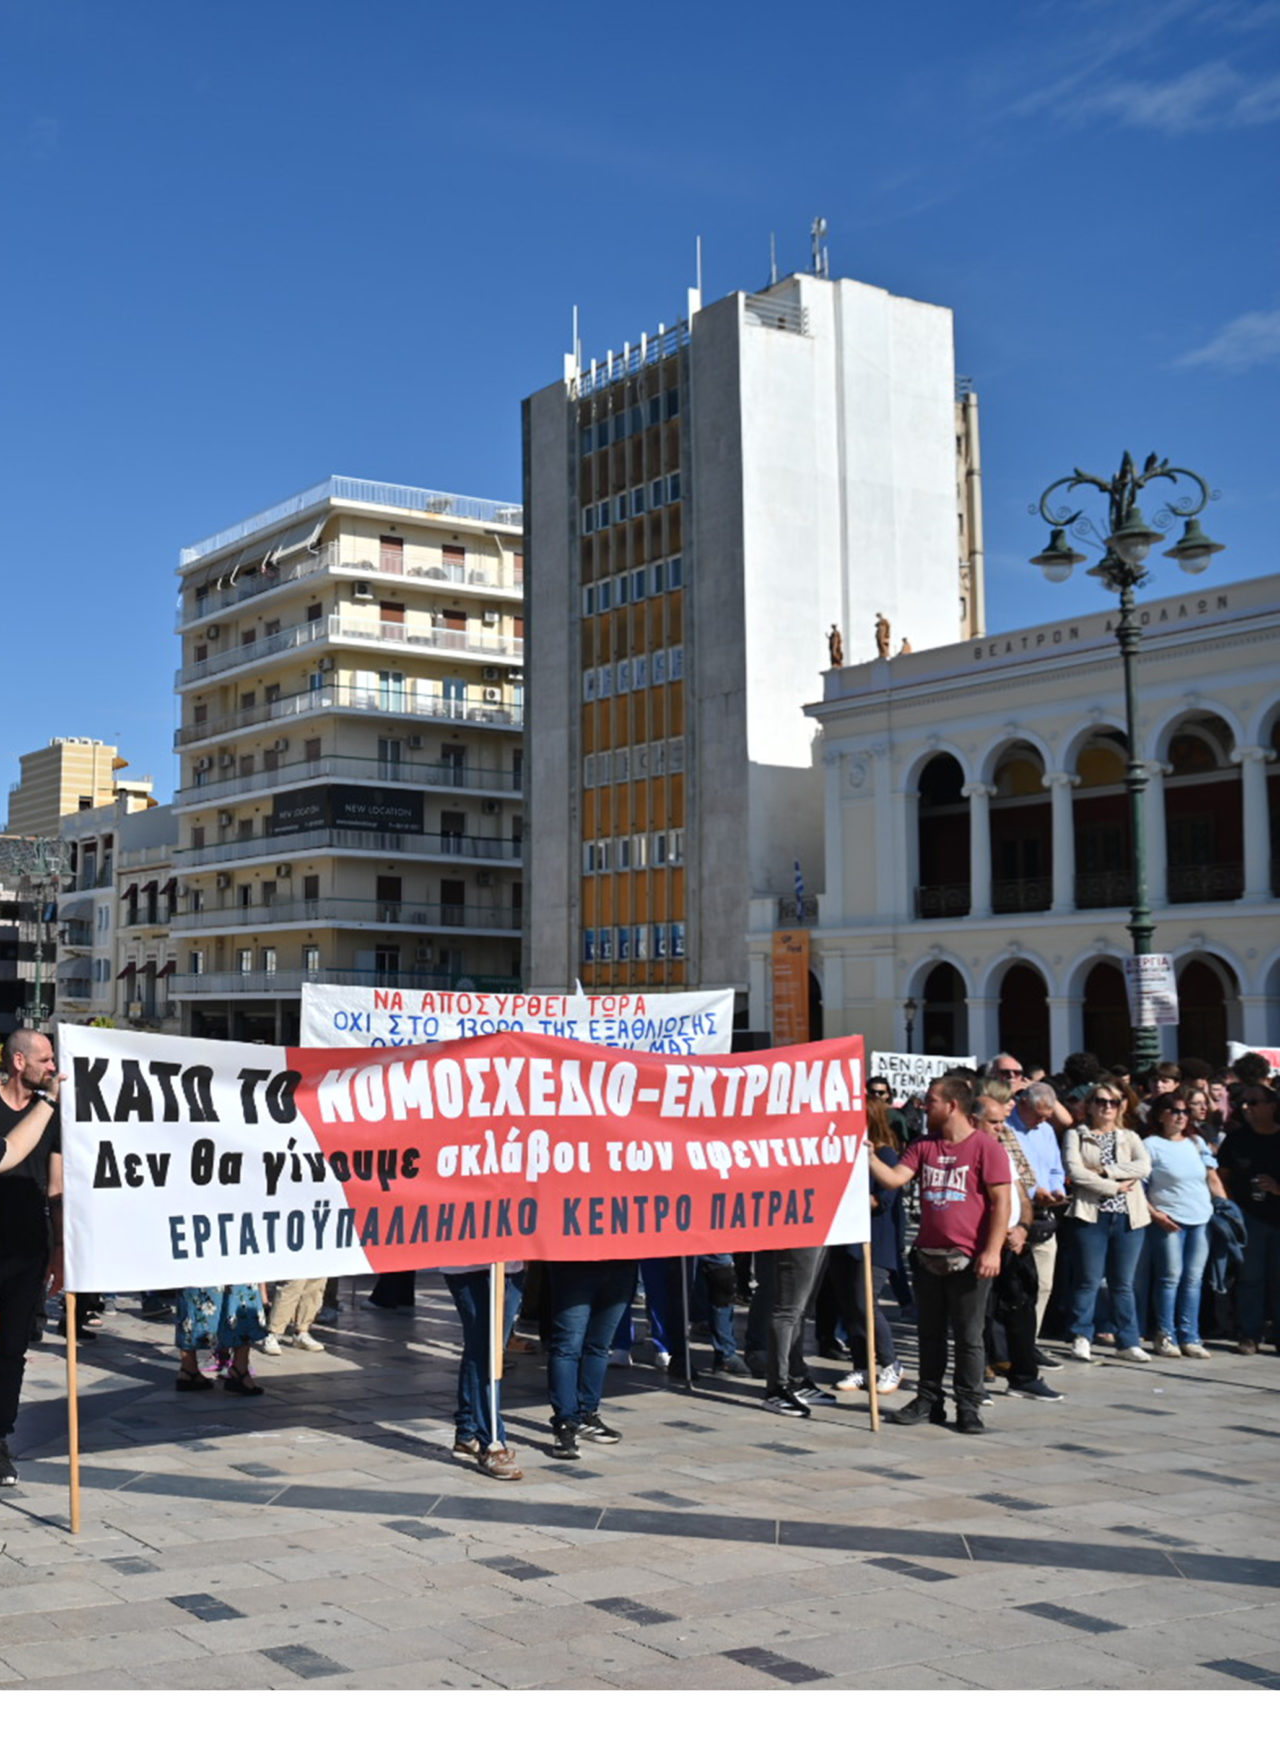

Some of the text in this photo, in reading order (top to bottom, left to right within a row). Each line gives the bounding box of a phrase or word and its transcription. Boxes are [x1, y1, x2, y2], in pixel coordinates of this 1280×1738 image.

[1105, 596, 1228, 633] ΑΟΛΛΩΝ
[345, 804, 412, 817] NEW LOCATION
[374, 990, 646, 1017] ΝΑ ΑΠΟΣΥΡΘΕΙ ΤΩΡΑ
[333, 1011, 370, 1034] ΟΧΙ
[388, 1014, 439, 1037] ΣΤΟ
[538, 1020, 580, 1041] ΤΗΣ
[589, 1013, 718, 1040] ΕΞΑΘΛΙΩΣΗΣ
[878, 1056, 911, 1072] ΔΕΝ
[914, 1058, 933, 1075] ΘΑ
[892, 1072, 926, 1087] ΓΕΝΙΑ
[73, 1056, 221, 1123] ΚΑΤΩ
[237, 1068, 303, 1124] ΤΟ
[93, 1140, 171, 1189] Δεν
[263, 1137, 421, 1196] γίνουμε
[436, 1126, 591, 1182] σκλάβοι
[606, 1139, 674, 1172] των
[686, 1122, 857, 1179] αφεντικών
[168, 1187, 816, 1260] ΕΡΓΑΤΟΫΠΑΛΛΗΛΙΚΟ ΚΕΝΤΡΟ ΠΑΤΡΑΣ
